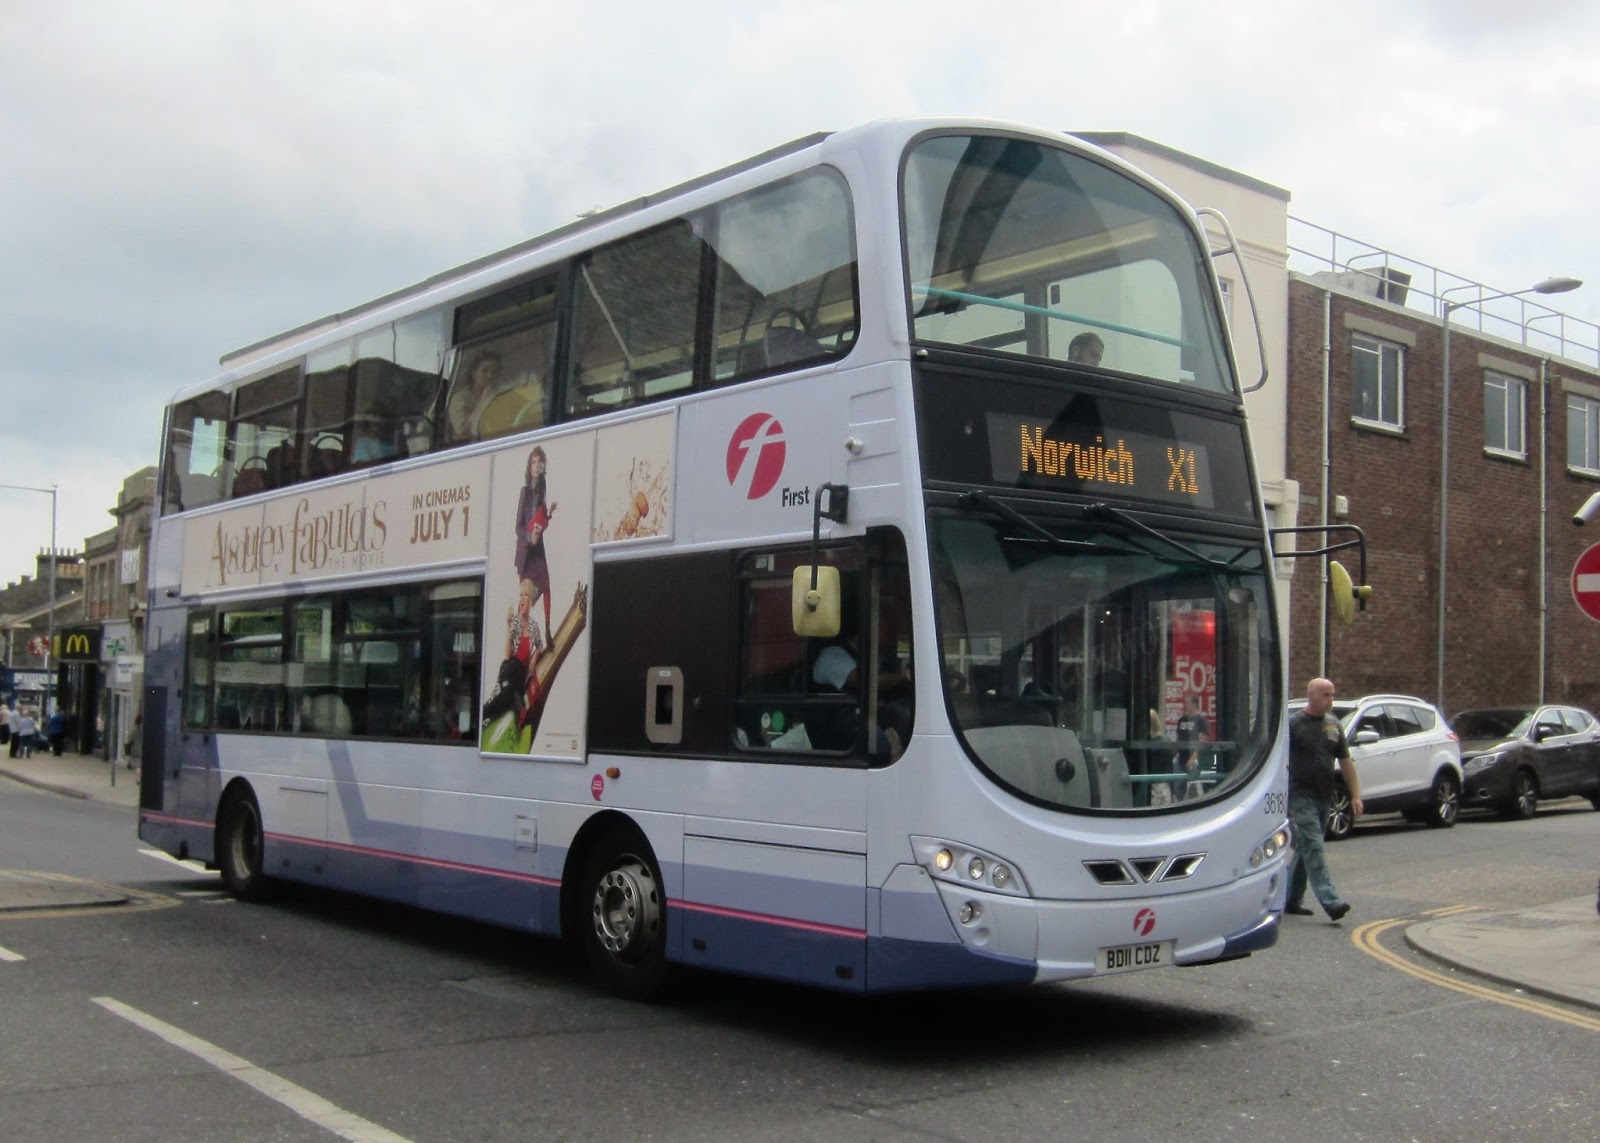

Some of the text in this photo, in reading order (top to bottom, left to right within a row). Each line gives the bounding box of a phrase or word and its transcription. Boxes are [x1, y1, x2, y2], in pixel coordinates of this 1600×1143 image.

[1021, 424, 1199, 494] Norwich X1
[412, 485, 470, 510] IN CINEMAS
[782, 486, 810, 507] First
[410, 506, 469, 544] JULY 1
[328, 557, 346, 569] THE
[1106, 944, 1160, 969] BD11 CDZ
